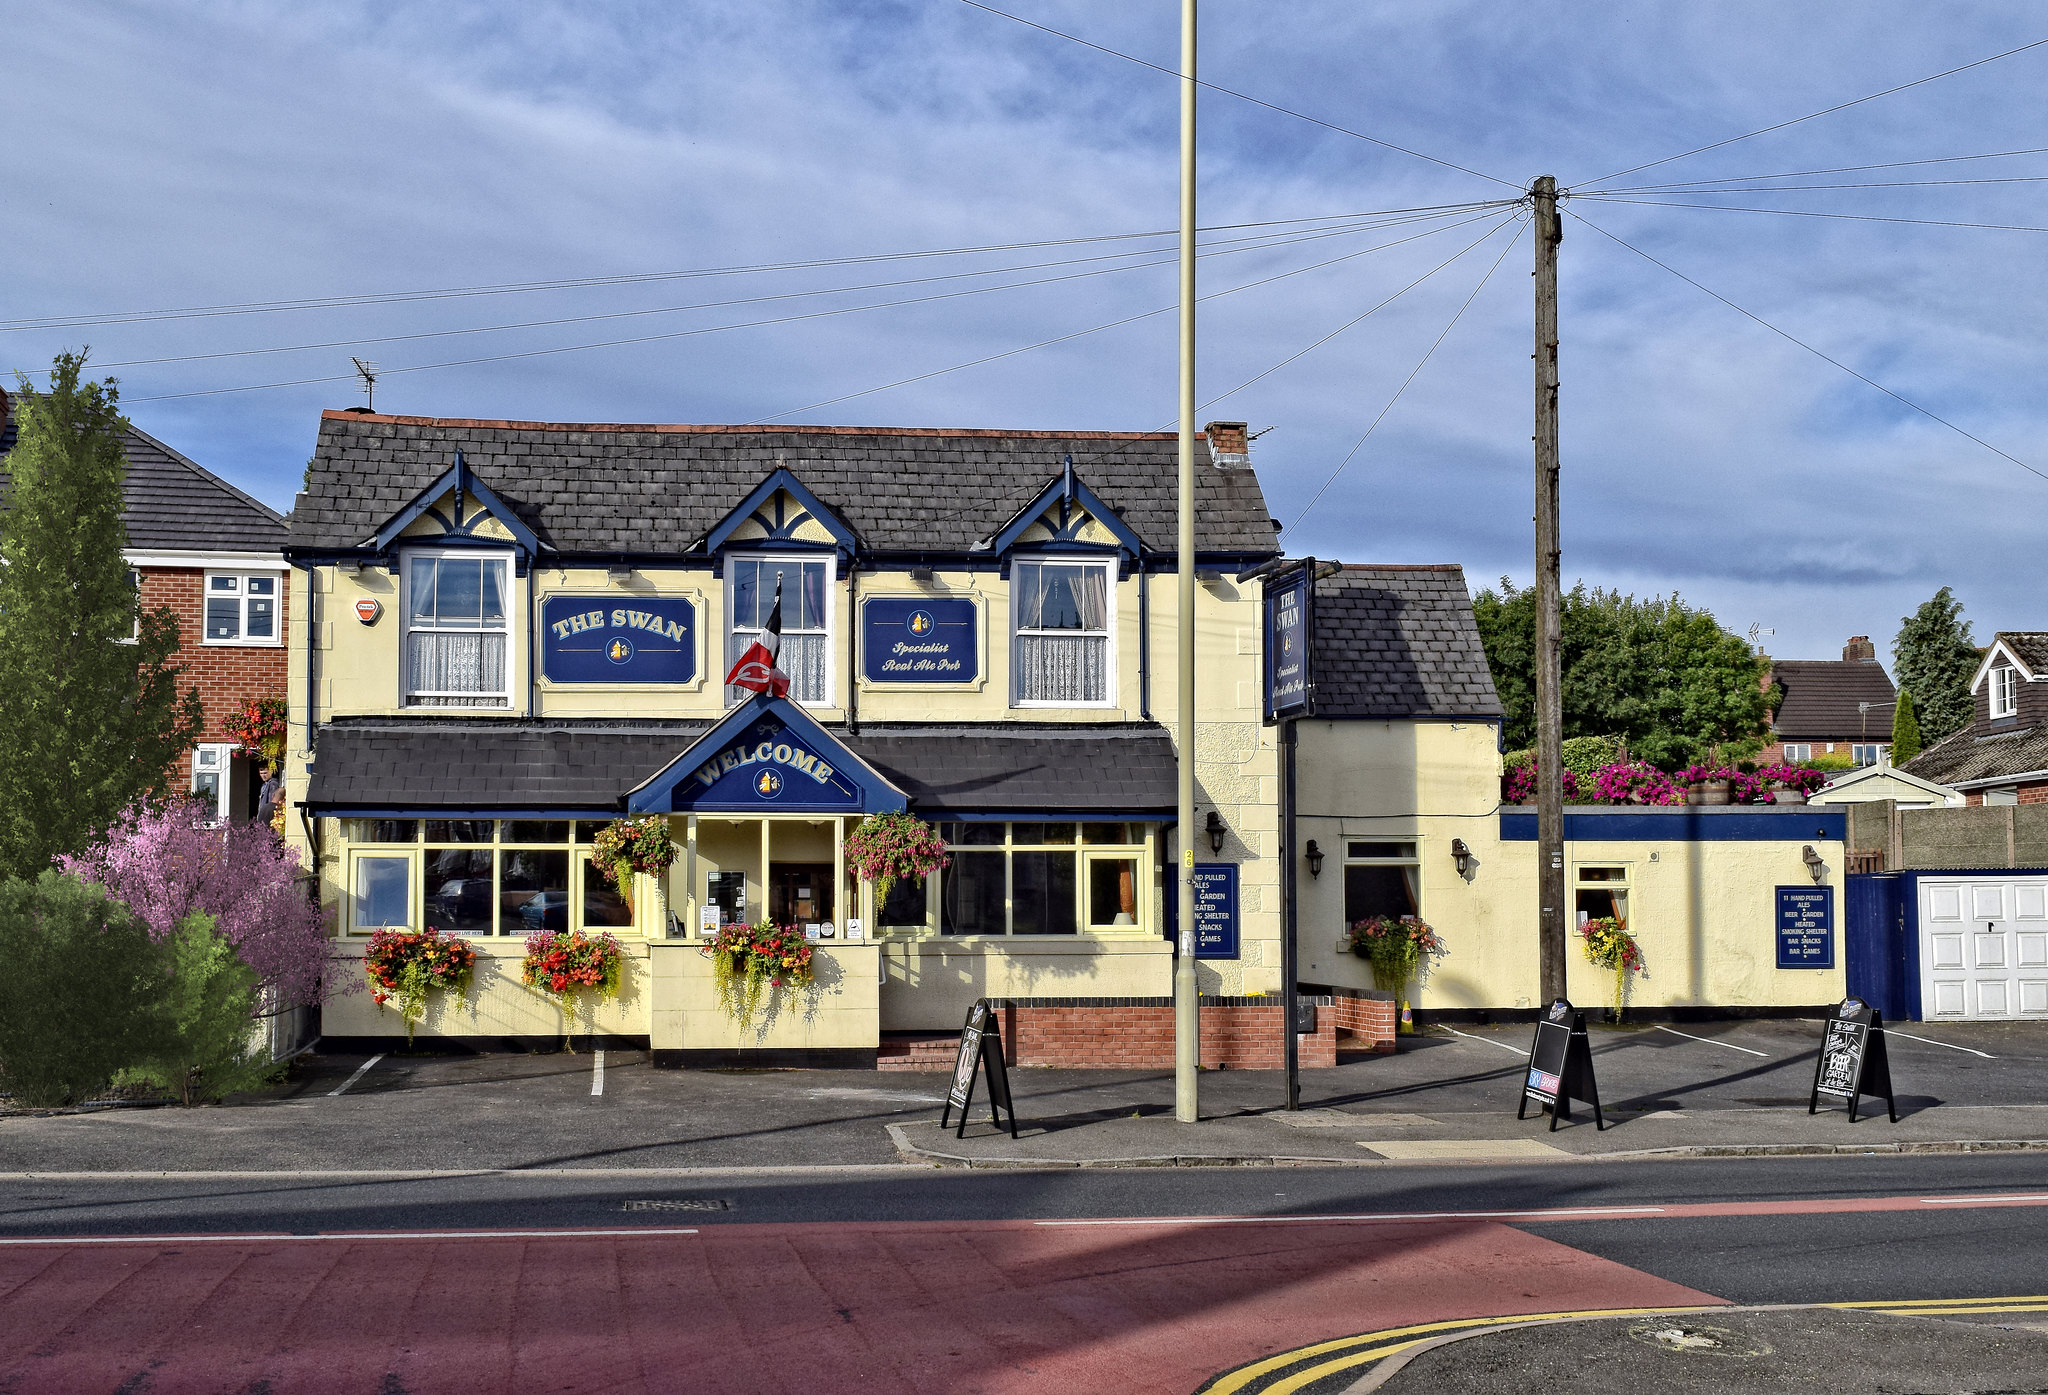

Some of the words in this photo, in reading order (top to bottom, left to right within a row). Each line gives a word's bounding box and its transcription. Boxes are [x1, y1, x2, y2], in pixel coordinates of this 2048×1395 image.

[1280, 590, 1295, 609] THE
[551, 610, 605, 640] THE
[611, 609, 687, 642] SWAN
[1276, 606, 1299, 632] SWAN
[892, 641, 949, 656] Specialist
[882, 659, 913, 671] Real
[913, 659, 936, 671] Ale
[937, 659, 960, 671] Pub
[693, 741, 834, 787] WELCOME
[1830, 1053, 1851, 1072] BEER
[1826, 1070, 1851, 1082] GARDEN
